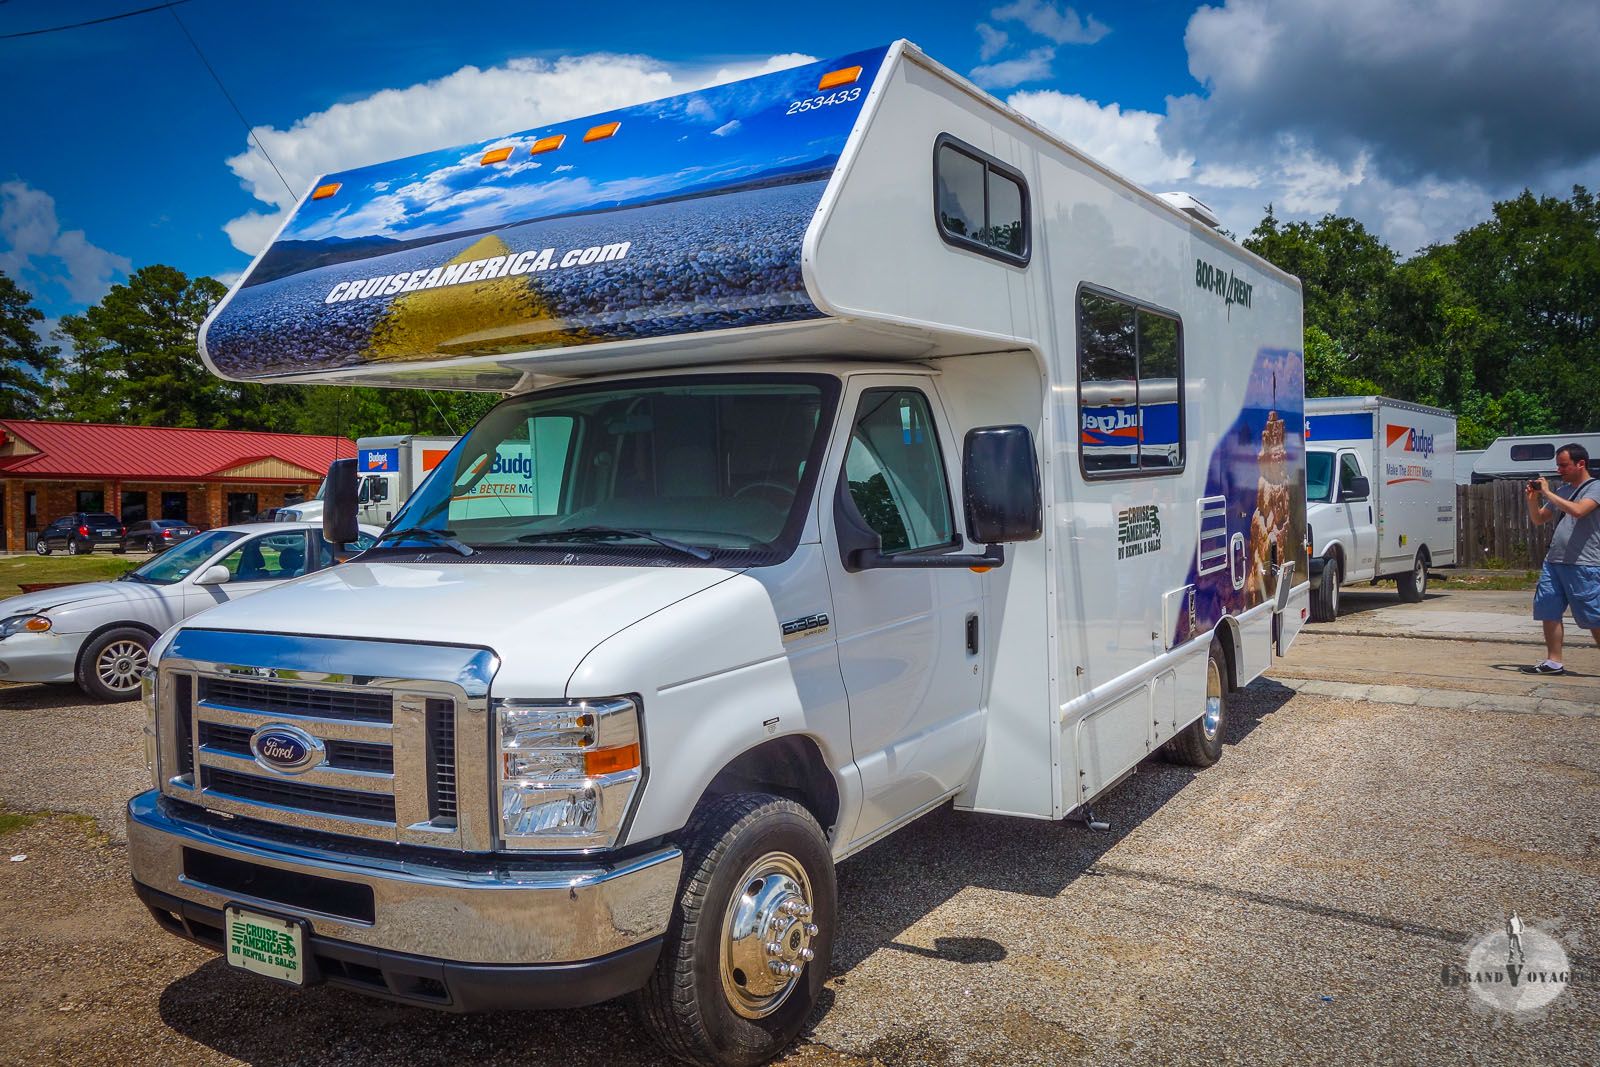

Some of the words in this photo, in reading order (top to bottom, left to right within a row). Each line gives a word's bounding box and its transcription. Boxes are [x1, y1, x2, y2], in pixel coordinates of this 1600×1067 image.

[786, 87, 861, 115] 253433
[325, 241, 631, 303] CRUISEAMERICA.com
[1410, 427, 1434, 459] Budget
[368, 452, 388, 464] Budget
[1386, 463, 1398, 475] Make
[1407, 465, 1421, 476] BETTER
[1422, 466, 1432, 478] Move
[480, 484, 516, 493] BETTER
[1128, 505, 1150, 525] CRUISE
[1126, 521, 1152, 543] AMERICA
[1125, 542, 1143, 559] RENTAL
[1147, 538, 1161, 553] SALES
[263, 737, 295, 760] Ford
[245, 923, 279, 943] CRUISE
[242, 934, 284, 957] AMERICA
[231, 944, 241, 955] RV
[242, 947, 267, 964] RENTAL
[267, 954, 273, 965] &
[274, 956, 297, 970] SALES
